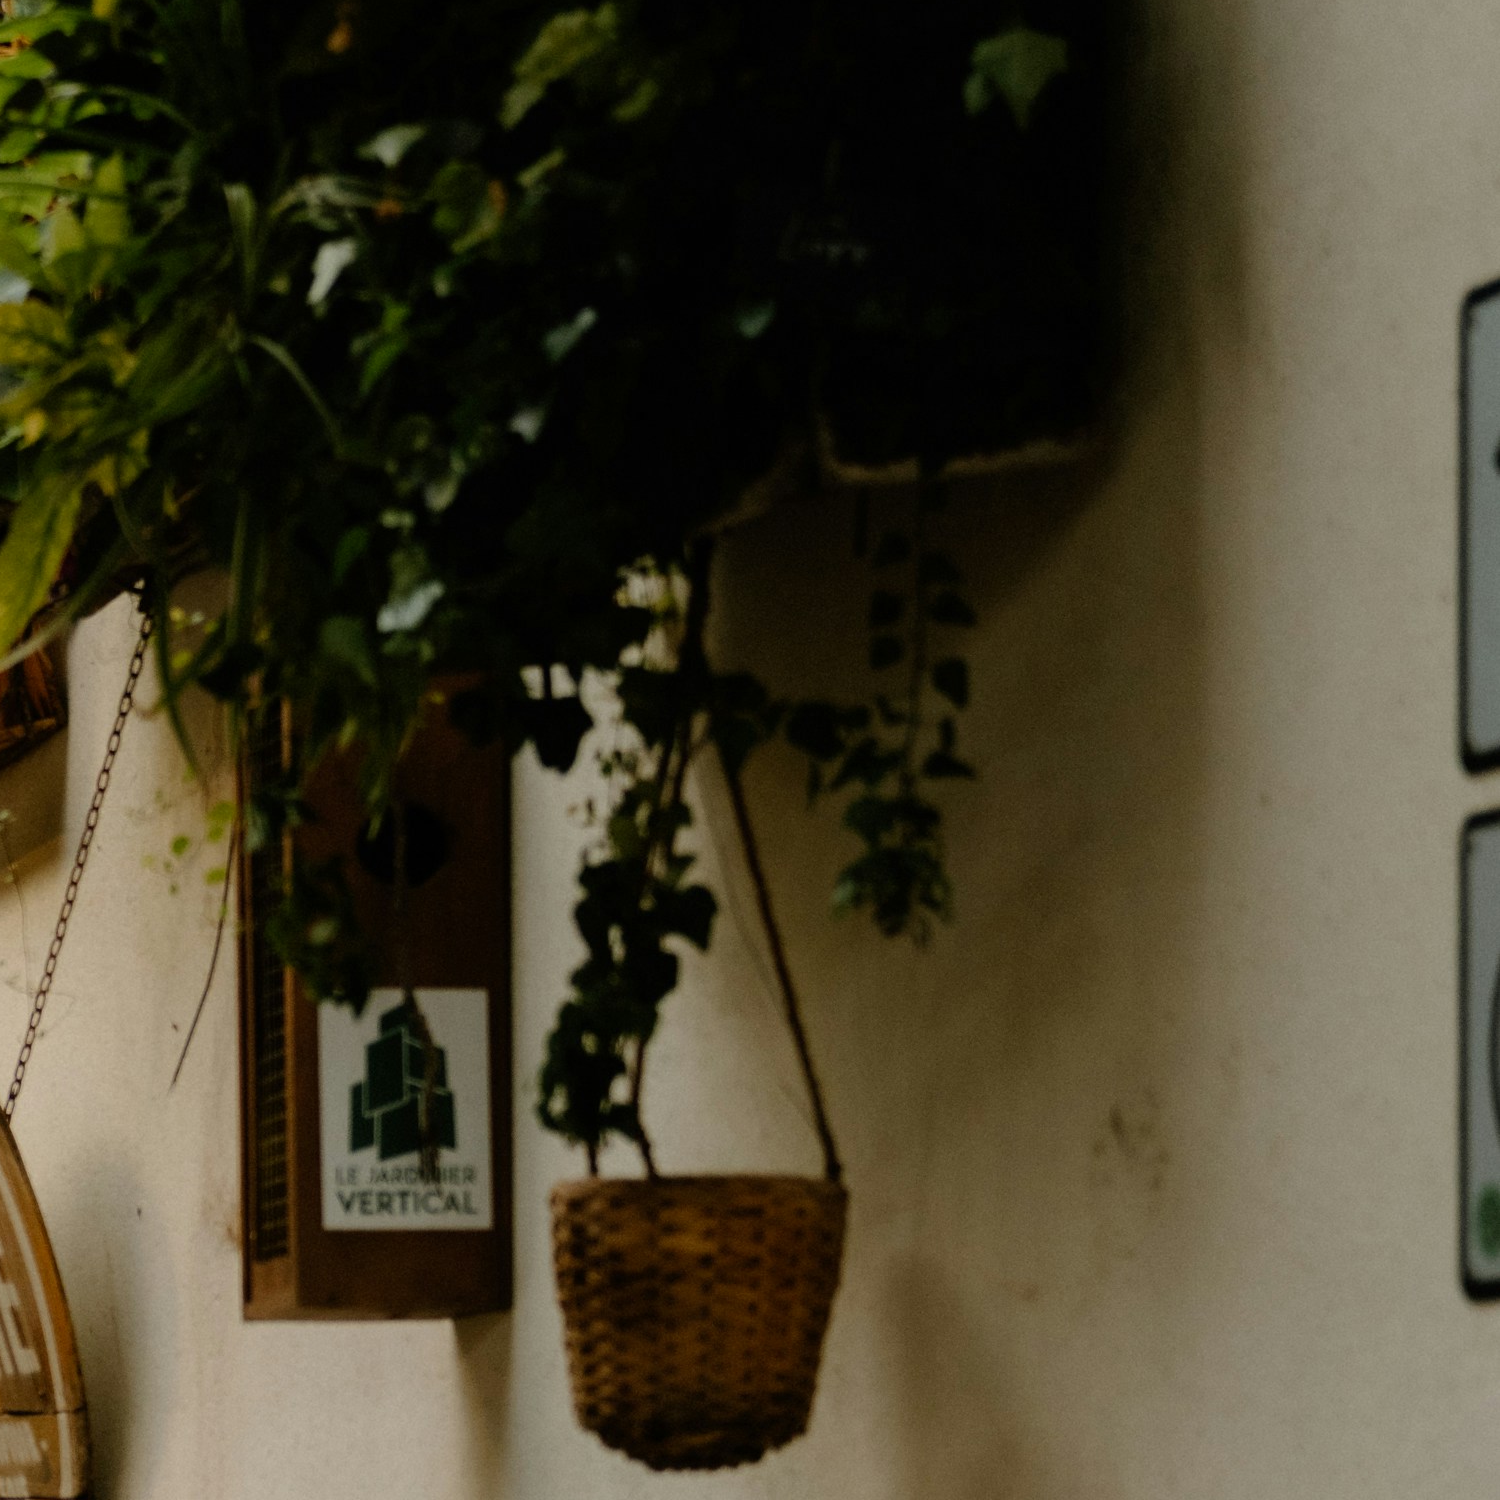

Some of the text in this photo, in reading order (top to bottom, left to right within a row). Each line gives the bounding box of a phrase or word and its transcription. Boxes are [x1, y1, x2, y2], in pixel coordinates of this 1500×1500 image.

[335, 1165, 477, 1185] LE JARDIIER
[335, 1189, 478, 1215] VERTICAL
